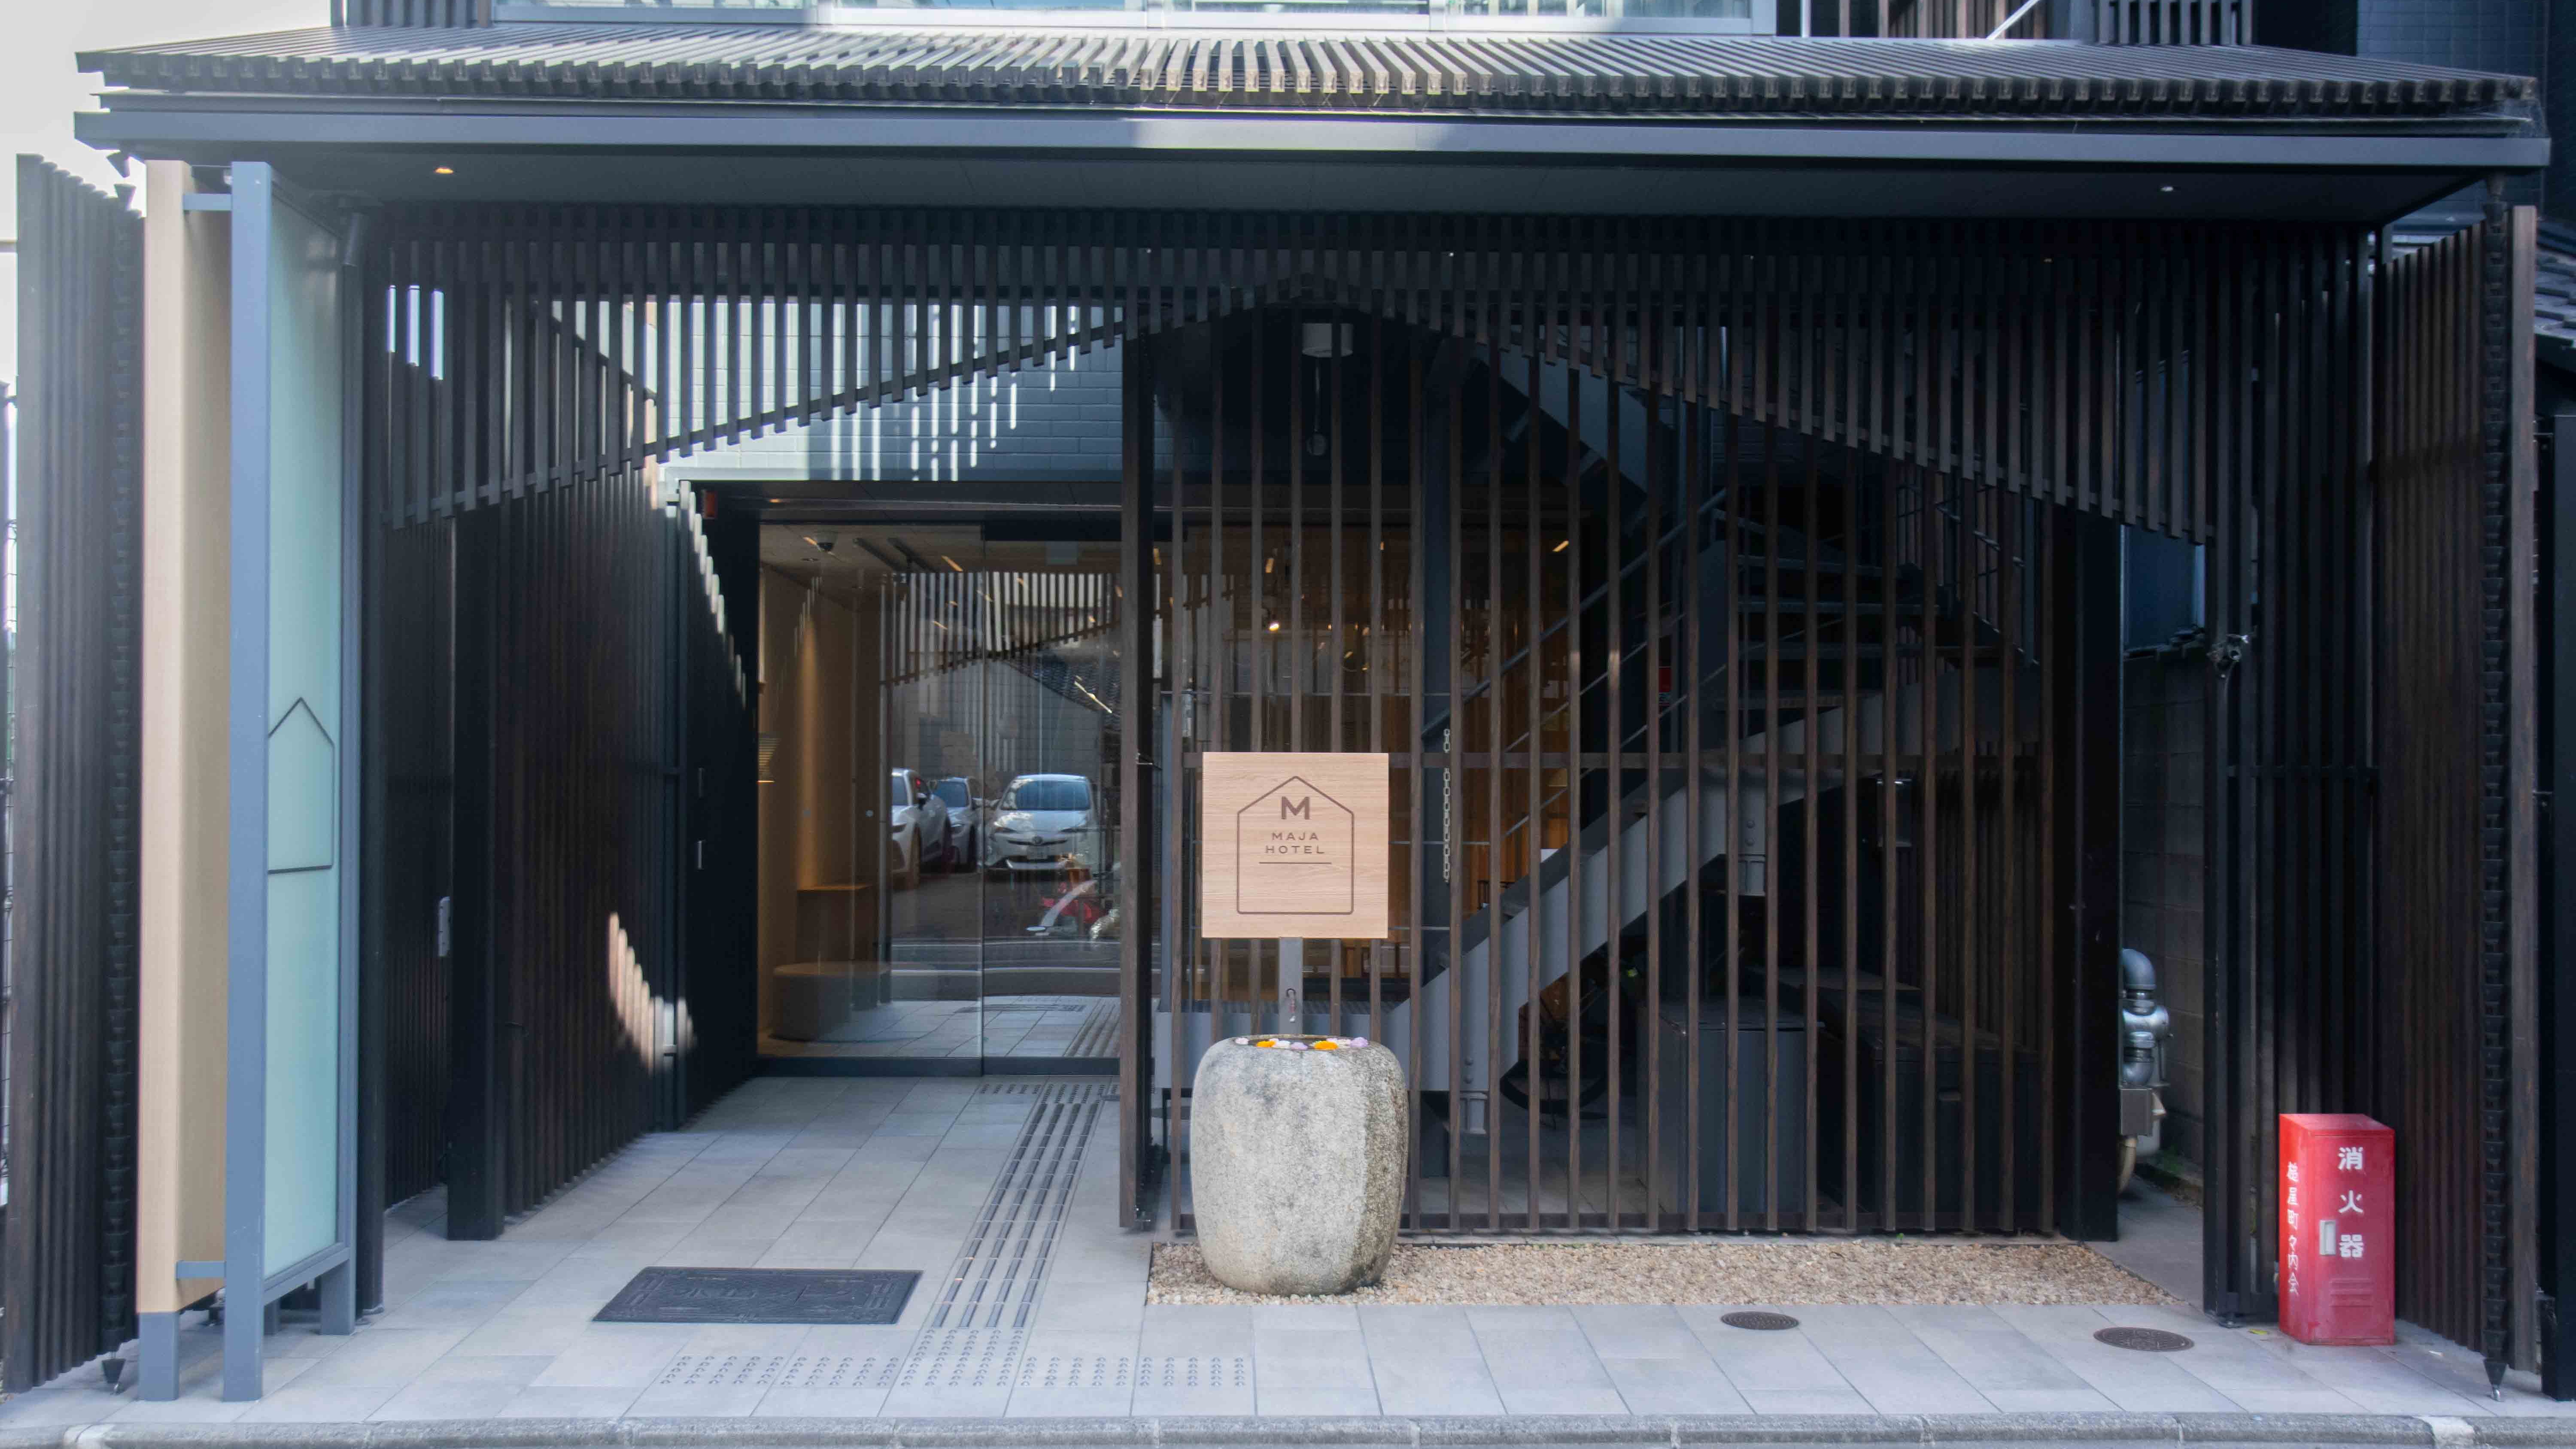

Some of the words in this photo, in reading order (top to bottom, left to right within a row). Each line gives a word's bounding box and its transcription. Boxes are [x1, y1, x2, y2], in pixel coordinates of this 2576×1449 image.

[1281, 796, 1310, 820] M
[1271, 832, 1319, 841] MAJA
[1265, 845, 1325, 854] HOTEL
[2338, 1147, 2363, 1258] 消火器
